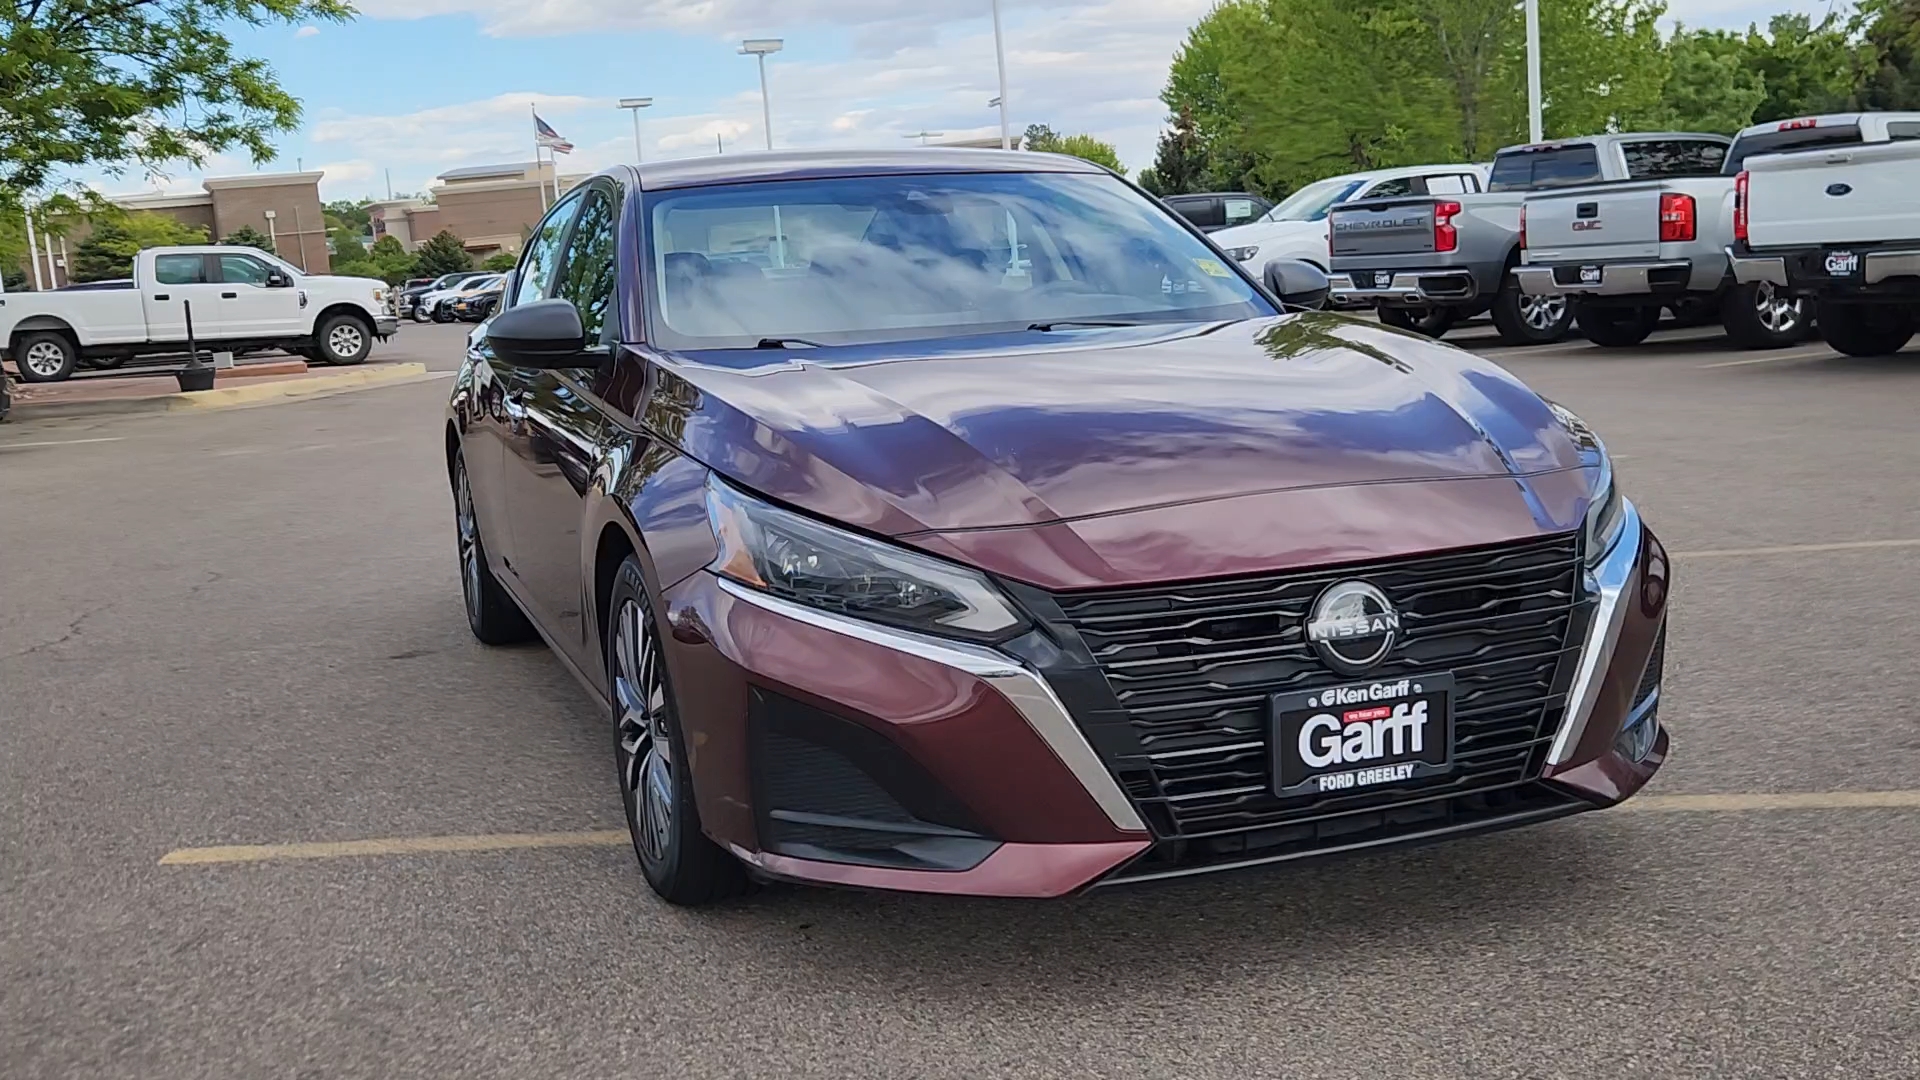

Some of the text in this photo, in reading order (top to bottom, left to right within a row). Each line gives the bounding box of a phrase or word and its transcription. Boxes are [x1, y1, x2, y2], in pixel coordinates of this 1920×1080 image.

[1335, 218, 1424, 231] CHEVROLET
[1572, 220, 1603, 231] GMC
[1825, 255, 1858, 272] Garff
[1311, 615, 1399, 639] NISSAN
[1336, 680, 1410, 705] Ken Garff
[1298, 700, 1428, 768] Garff
[1319, 763, 1414, 792] FORD GREELEY
